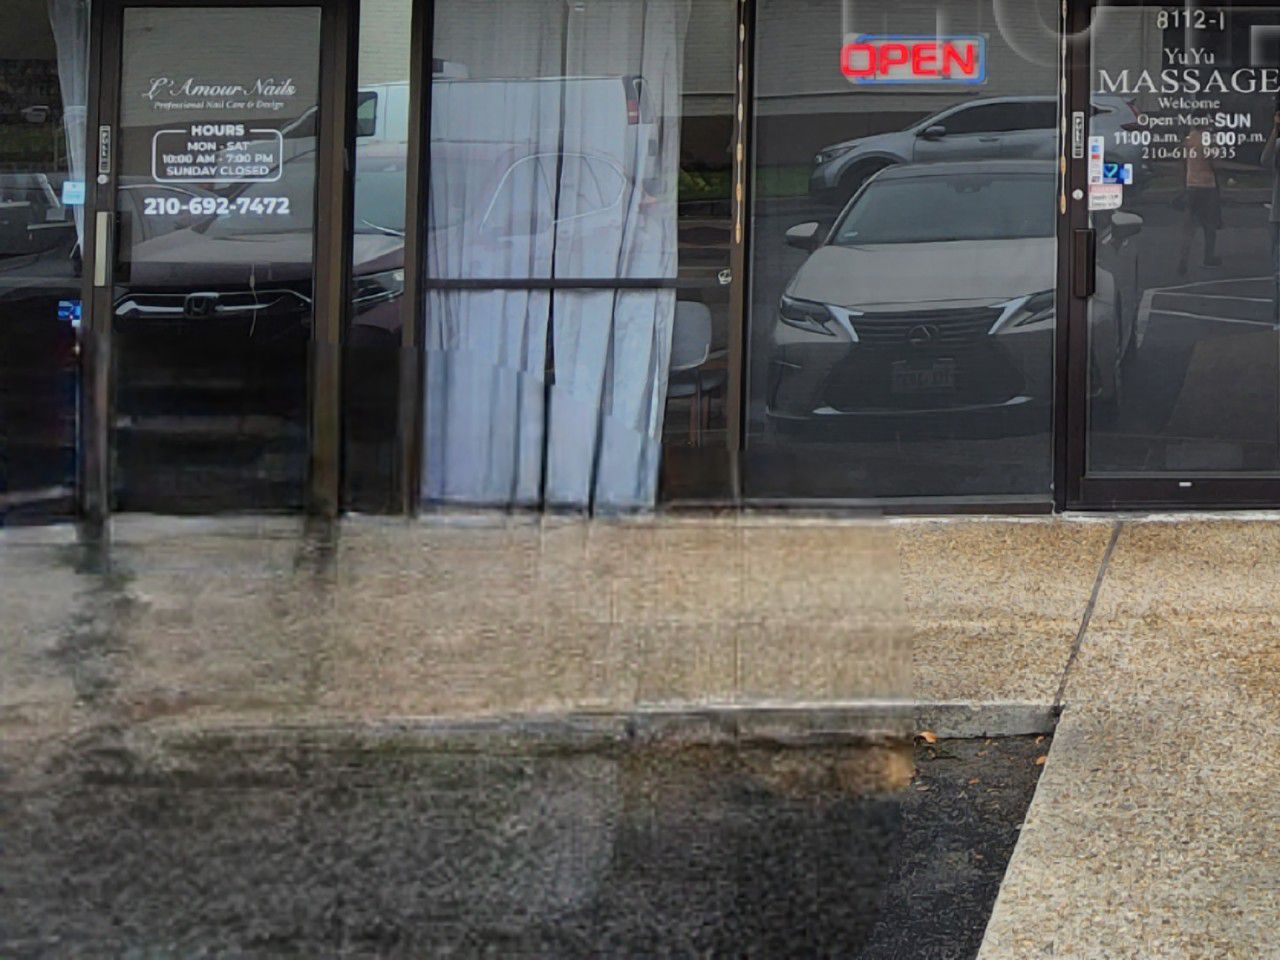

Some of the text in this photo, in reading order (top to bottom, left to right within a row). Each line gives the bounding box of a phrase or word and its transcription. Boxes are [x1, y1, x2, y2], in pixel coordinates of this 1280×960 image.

[840, 42, 976, 76] OPEN
[1163, 47, 1215, 65] YuYu
[243, 77, 297, 96] Nails
[206, 100, 224, 109] Nail
[1158, 97, 1221, 109] Welcome
[1137, 114, 1174, 129] Open
[191, 124, 245, 137] HOURS
[187, 142, 216, 151] MON
[226, 141, 250, 151] SAT
[162, 153, 193, 163] 10:00
[196, 154, 215, 163] AM
[226, 153, 251, 163] 7:00
[254, 153, 274, 163] PM
[166, 166, 269, 176] SUNDAY CLOSED
[144, 197, 290, 215] 210-692-7472
